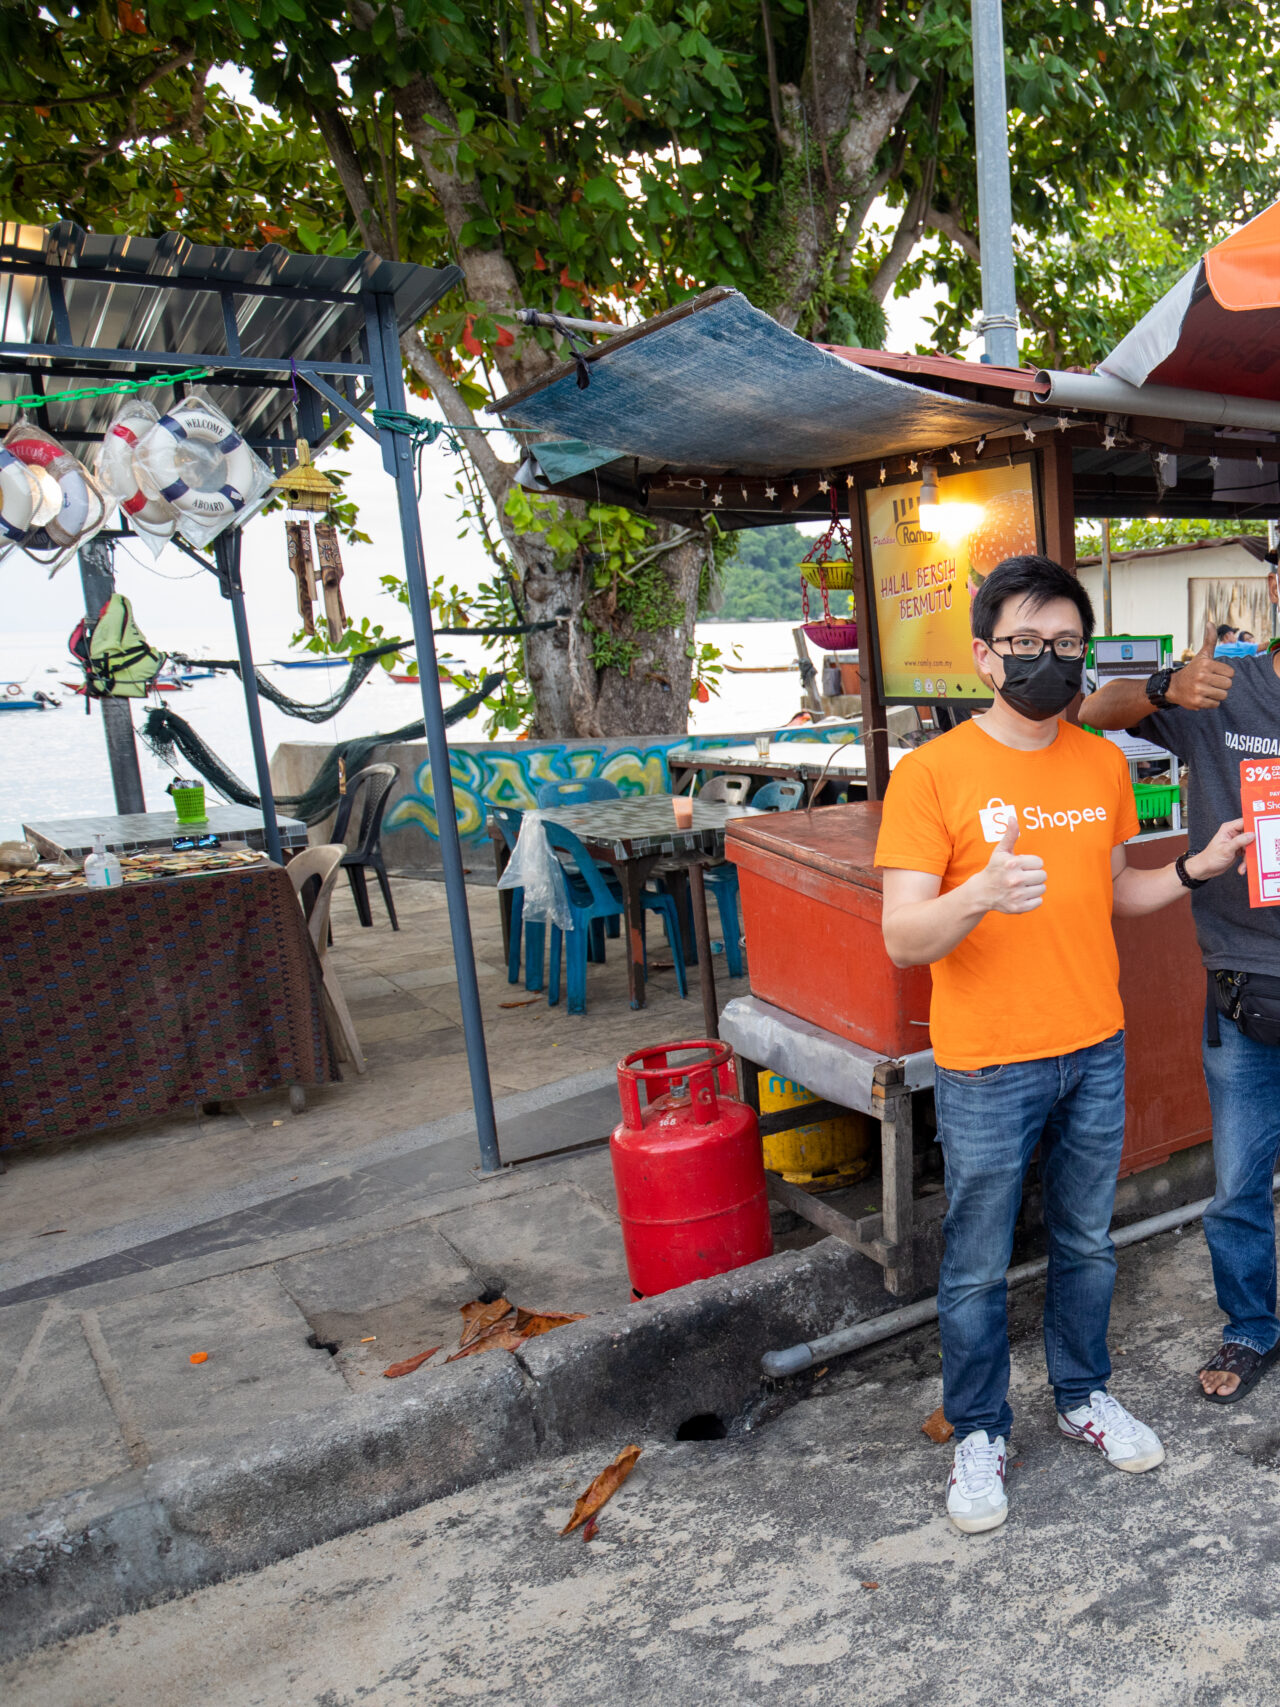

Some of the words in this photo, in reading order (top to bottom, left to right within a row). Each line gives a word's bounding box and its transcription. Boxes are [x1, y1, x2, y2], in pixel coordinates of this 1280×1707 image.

[185, 419, 225, 438] WELCOME
[192, 498, 225, 513] ABOARD
[880, 571, 913, 599] HALAL
[916, 559, 957, 589] BERSIH
[899, 588, 952, 621] BERMUTU
[1245, 766, 1272, 782] 3%
[1022, 805, 1107, 832] Shopee
[697, 1087, 712, 1105] G
